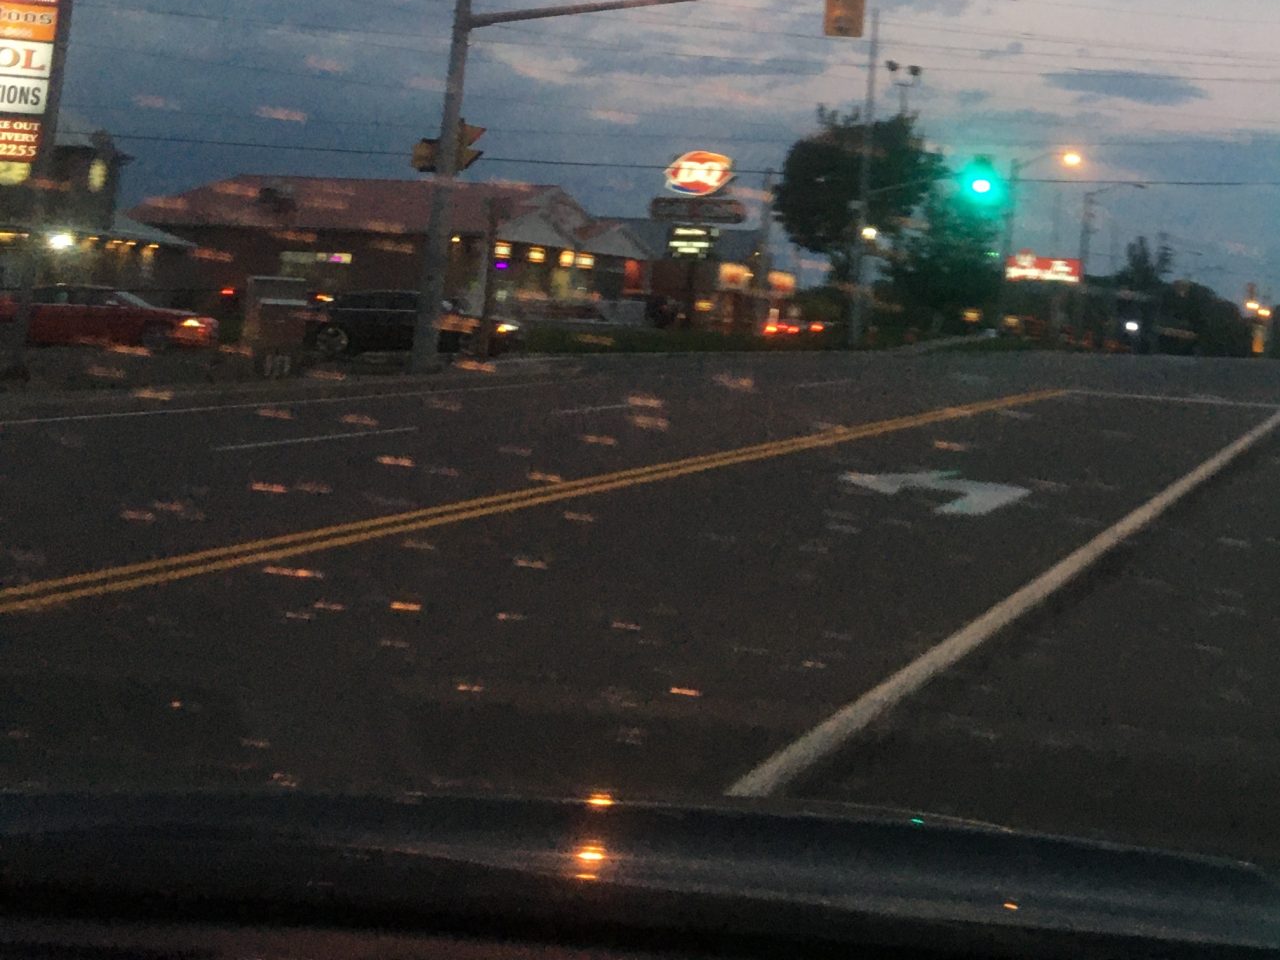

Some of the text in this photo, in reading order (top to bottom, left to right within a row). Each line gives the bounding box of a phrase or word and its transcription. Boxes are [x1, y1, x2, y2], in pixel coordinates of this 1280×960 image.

[0, 46, 46, 71] OL
[0, 84, 42, 106] IONS
[13, 121, 41, 131] OUT
